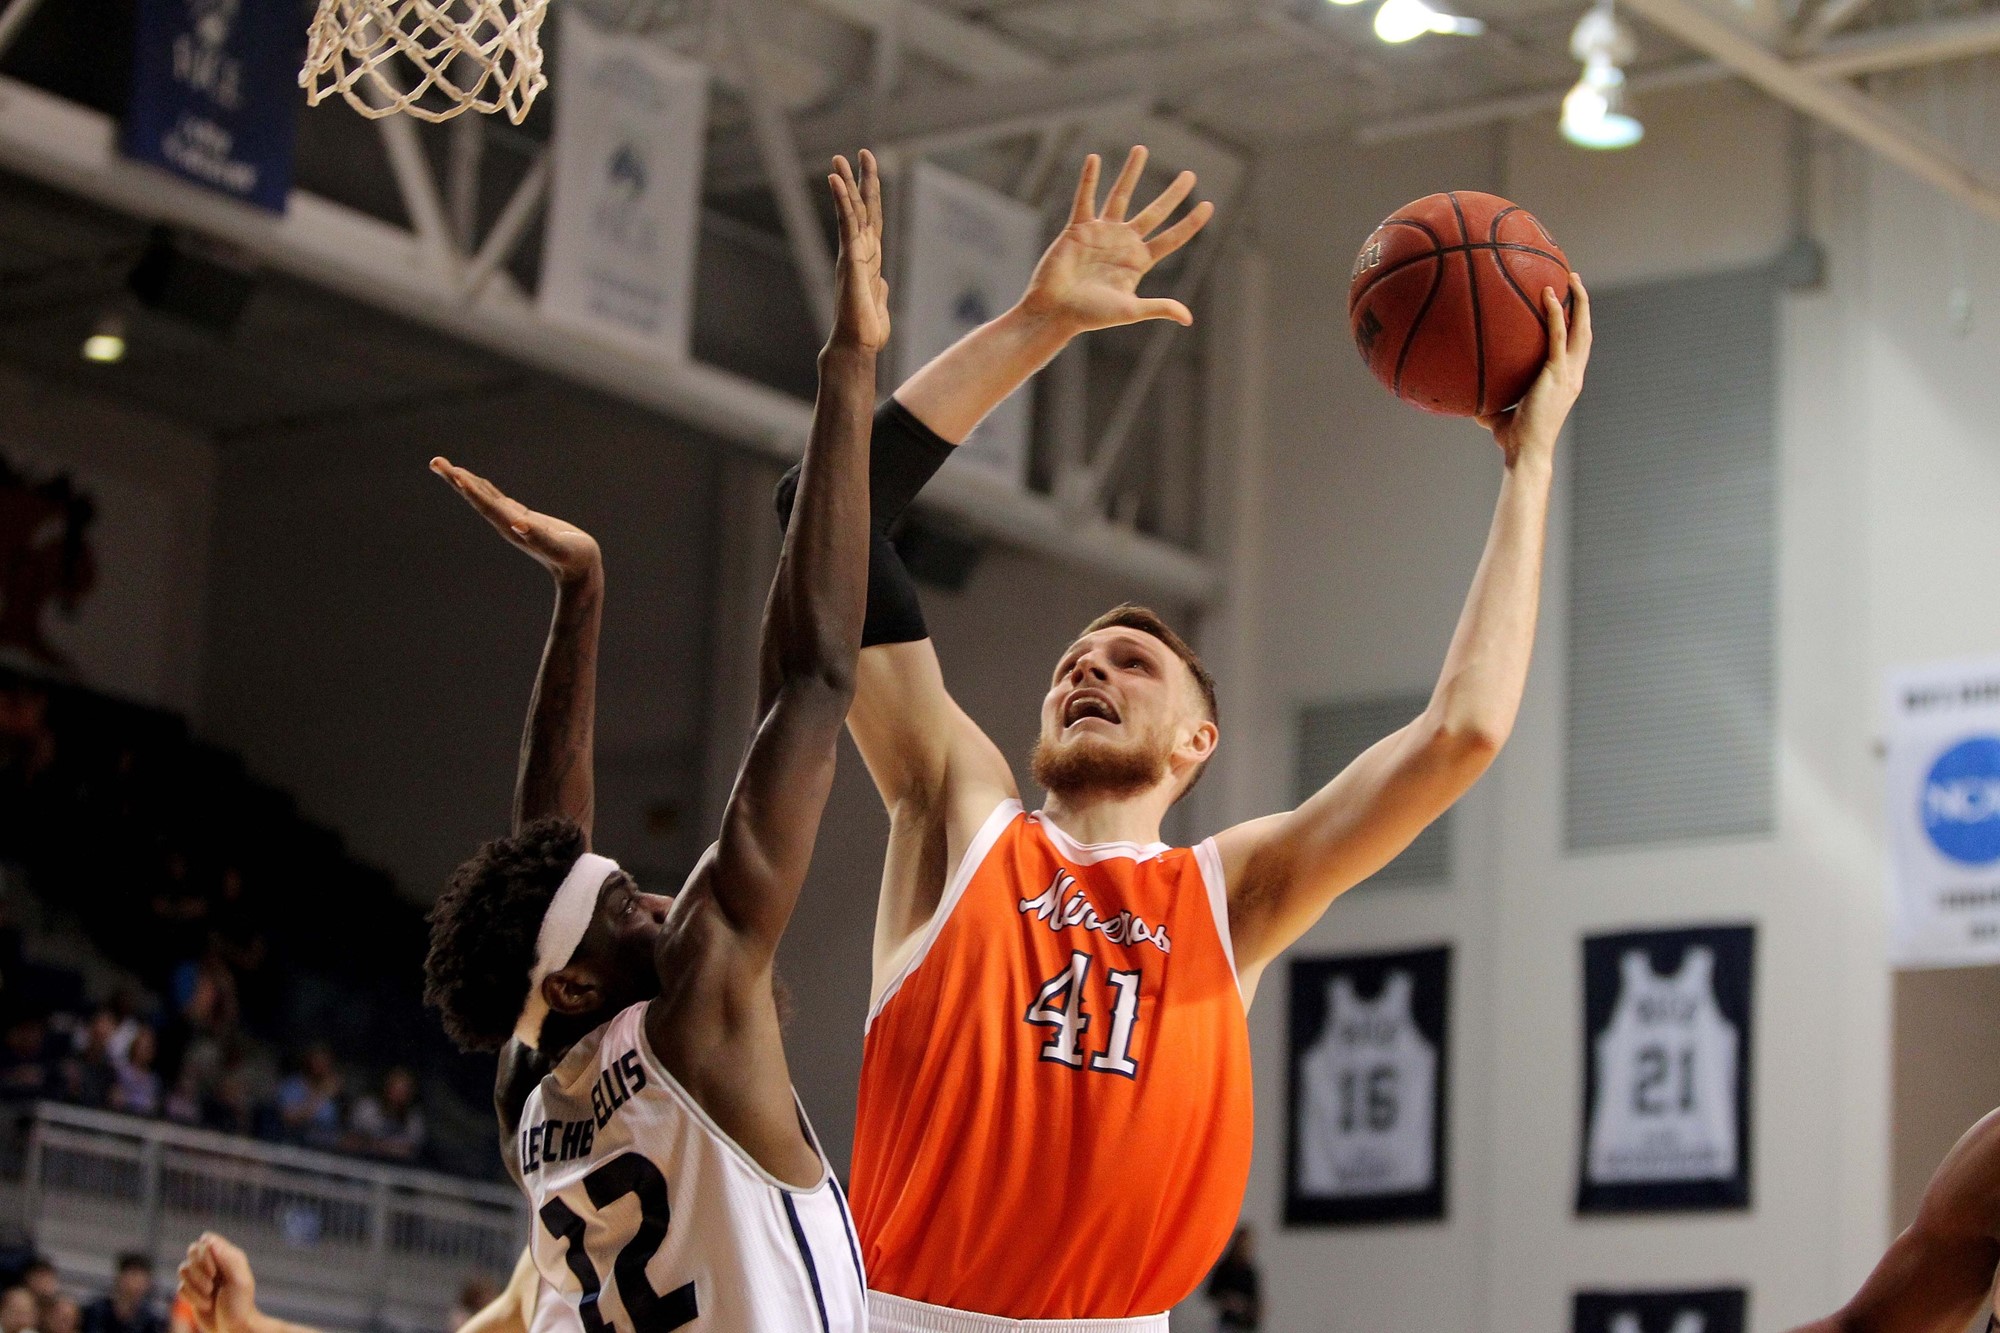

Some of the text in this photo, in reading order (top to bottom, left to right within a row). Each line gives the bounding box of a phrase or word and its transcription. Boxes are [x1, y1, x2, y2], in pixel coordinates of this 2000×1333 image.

[1023, 949, 1142, 1081] 41
[1336, 1063, 1399, 1136] 16
[1632, 1040, 1698, 1116] 21
[539, 1152, 698, 1333] 12
